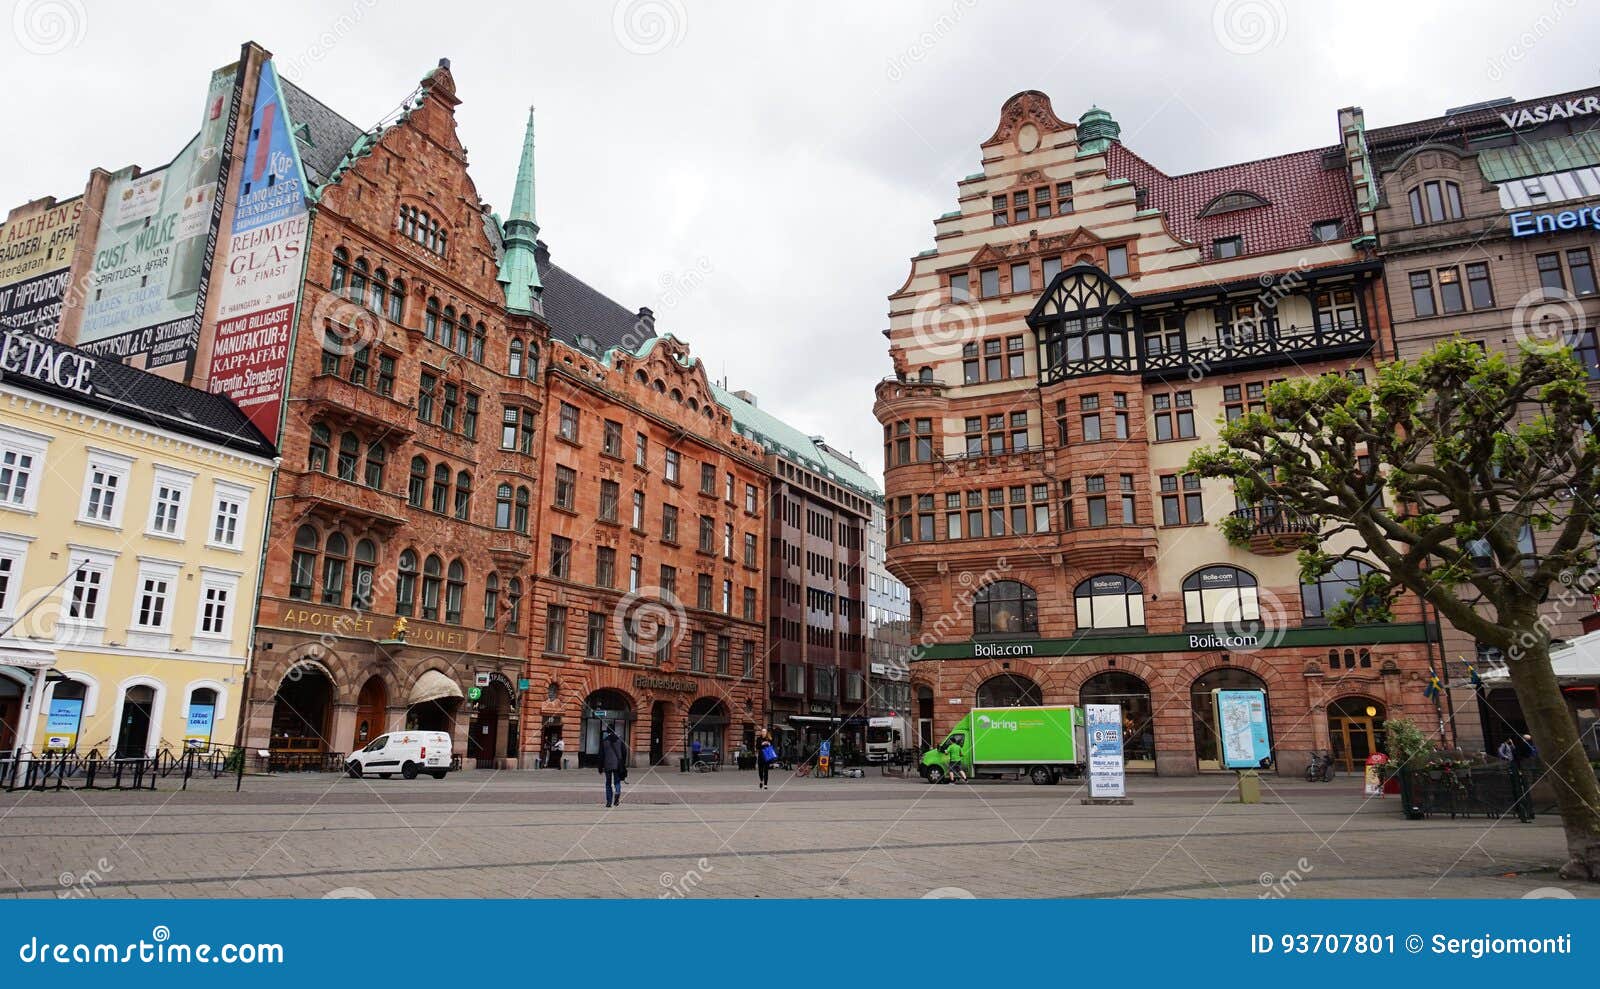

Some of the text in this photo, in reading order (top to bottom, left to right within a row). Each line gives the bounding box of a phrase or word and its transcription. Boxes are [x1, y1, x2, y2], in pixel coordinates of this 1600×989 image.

[96, 213, 179, 273] GUST. WOLKE
[55, 247, 66, 262] 12
[230, 240, 299, 275] GLAS
[95, 264, 140, 284] SPIRITUOSA
[249, 310, 288, 329] BILLIGASTE
[974, 643, 1033, 657] Bolia.com
[1188, 635, 1258, 649] Bolia.com
[991, 720, 1017, 731] bring
